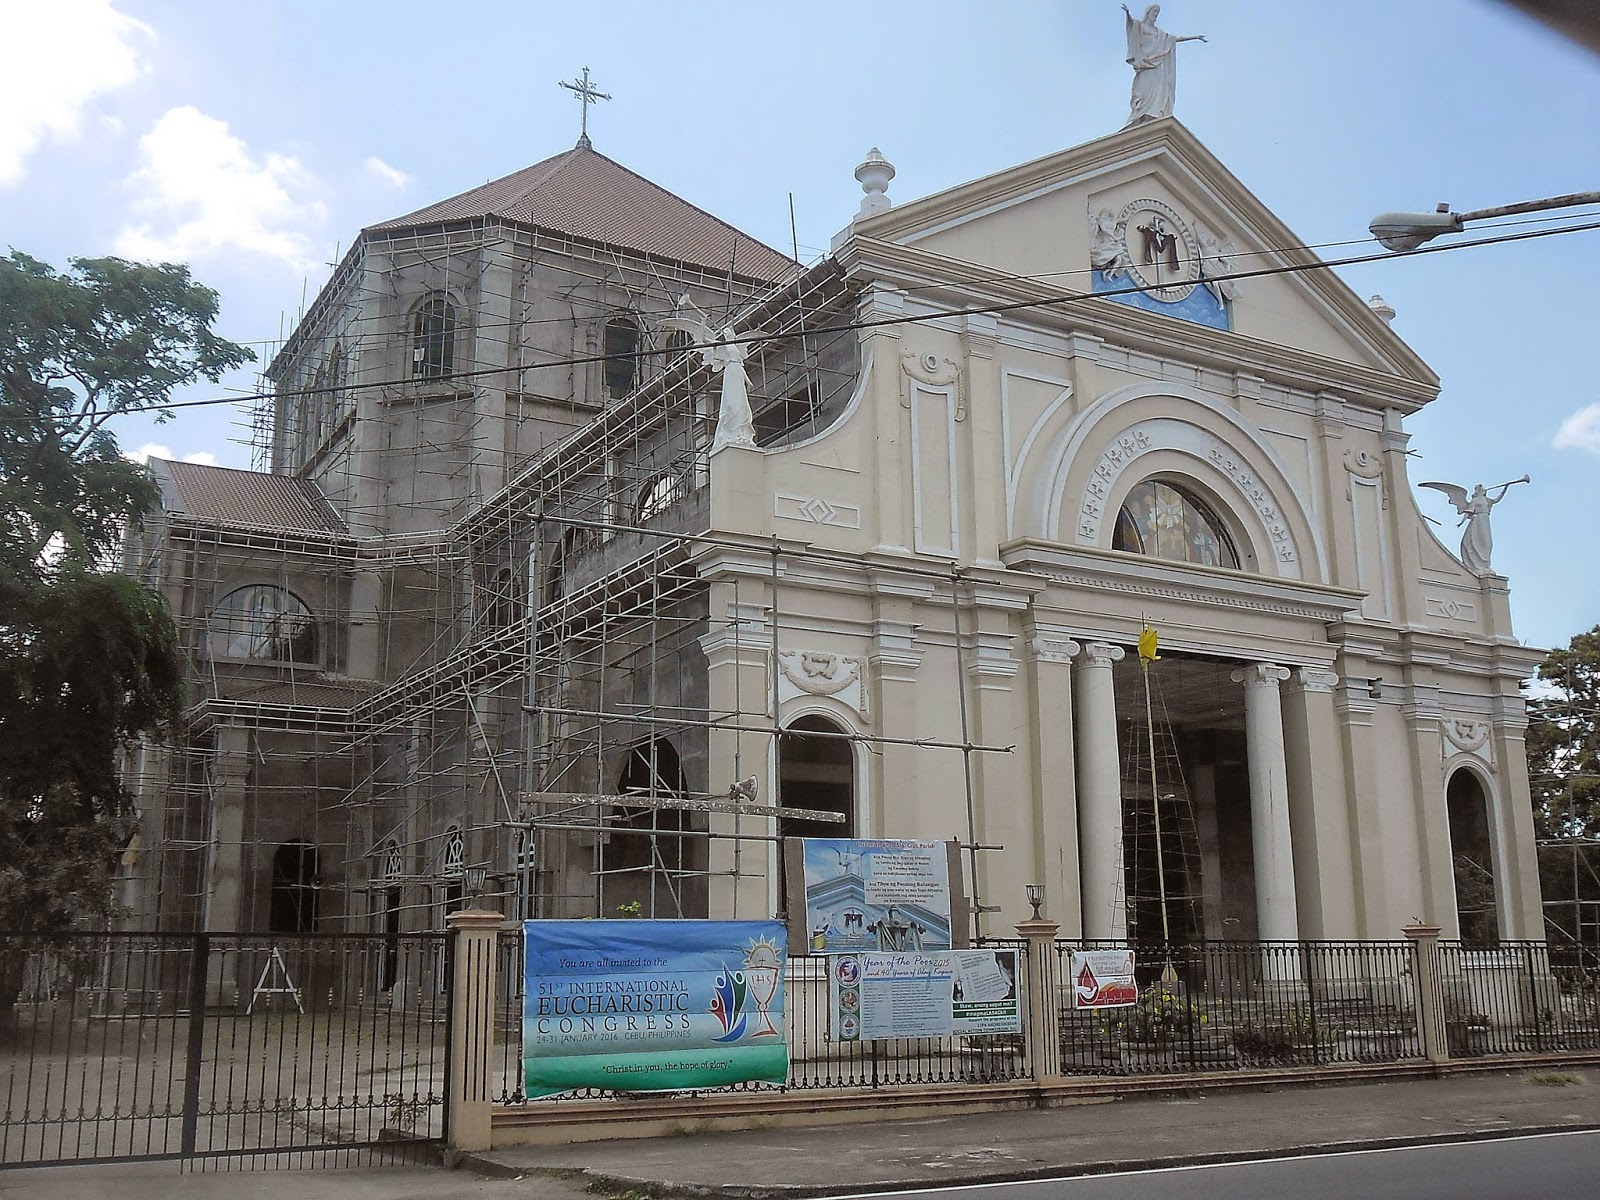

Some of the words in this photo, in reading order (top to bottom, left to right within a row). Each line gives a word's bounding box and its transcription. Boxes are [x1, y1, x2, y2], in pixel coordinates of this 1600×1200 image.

[560, 959, 576, 968] You
[597, 958, 608, 967] all
[610, 957, 641, 967] invited
[643, 959, 652, 967] to
[654, 957, 667, 966] the
[863, 956, 884, 971] Year
[887, 956, 895, 969] of
[896, 956, 910, 966] the
[914, 955, 933, 965] Poor
[933, 959, 950, 967] 2015
[752, 974, 771, 985] IHS
[539, 982, 563, 995] 51ST
[570, 980, 687, 994] INTERNATIONAL
[538, 993, 689, 1015] EUCHARISTIC
[538, 1014, 690, 1033] CONGRESS
[536, 1036, 558, 1044] 24-31
[561, 1033, 597, 1044] JANUARY
[600, 1033, 618, 1041] 2016
[624, 1032, 646, 1040] CEBU,
[648, 1030, 691, 1039] PHILIPPINES
[634, 1064, 642, 1072] in
[645, 1064, 662, 1073] you,
[665, 1061, 677, 1070] the
[680, 1062, 698, 1071] hope
[701, 1061, 708, 1069] of
